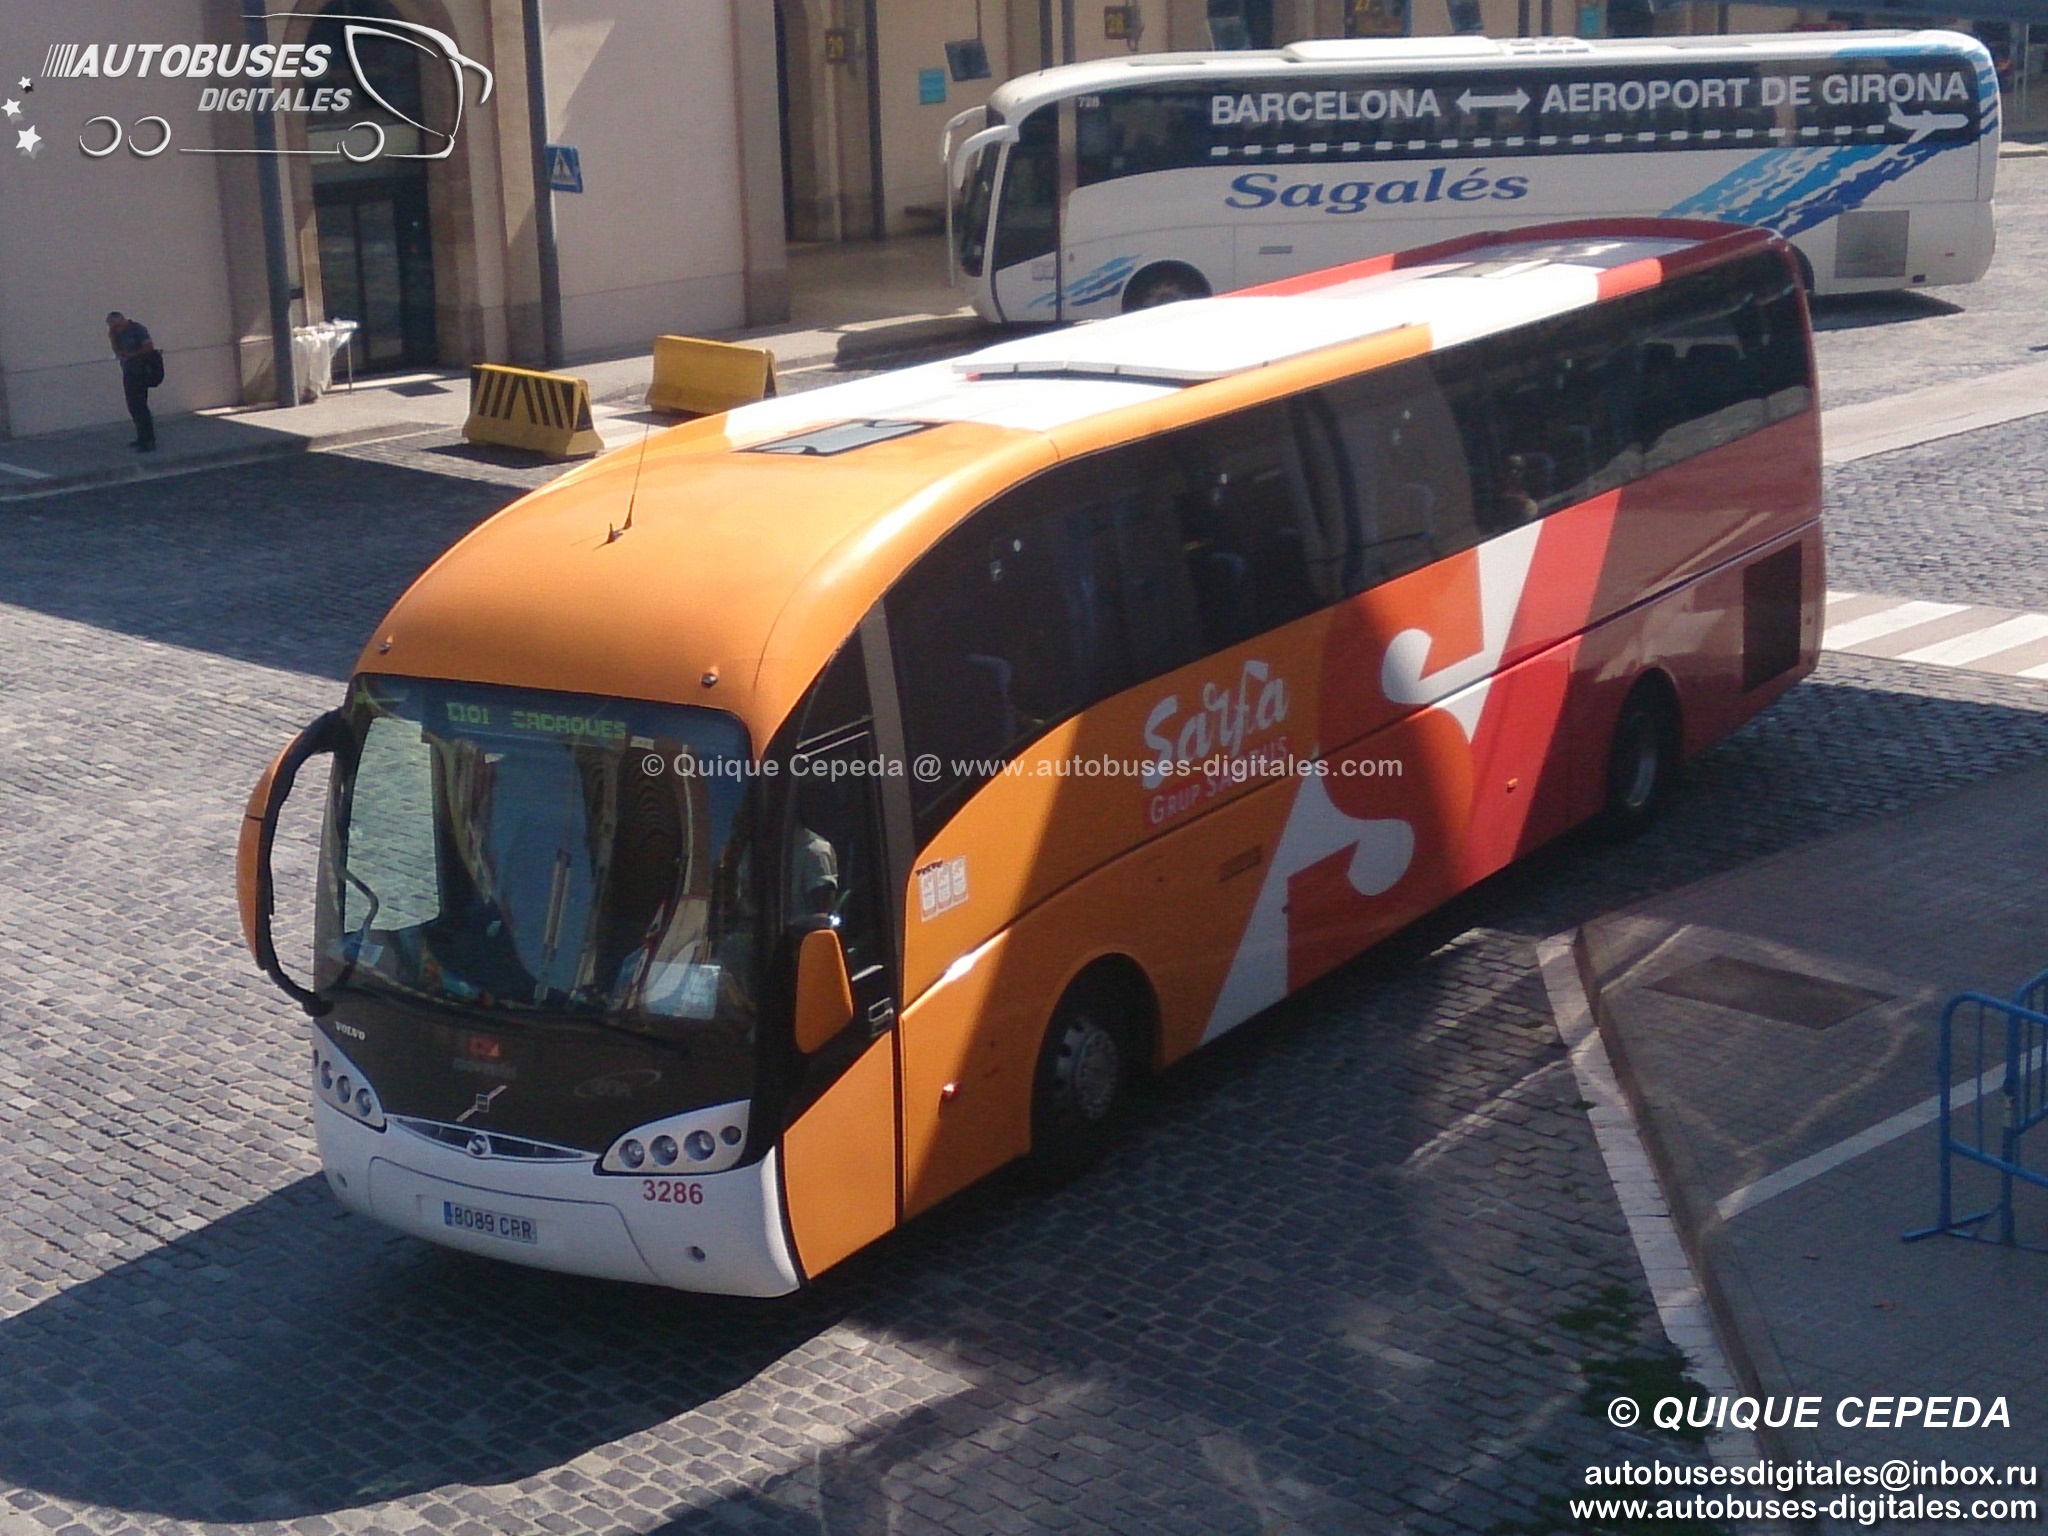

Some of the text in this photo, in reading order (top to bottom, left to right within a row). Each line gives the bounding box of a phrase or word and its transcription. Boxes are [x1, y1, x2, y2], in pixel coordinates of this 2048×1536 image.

[1211, 71, 1969, 125] BARCELONA AEROPORT DE GIRONA
[1224, 166, 1530, 214] Sagalés
[1142, 660, 1289, 790] Sarfa
[335, 1021, 366, 1041] VOLVO
[643, 1179, 704, 1205] 3286
[454, 1207, 532, 1240] 8089 CRR
